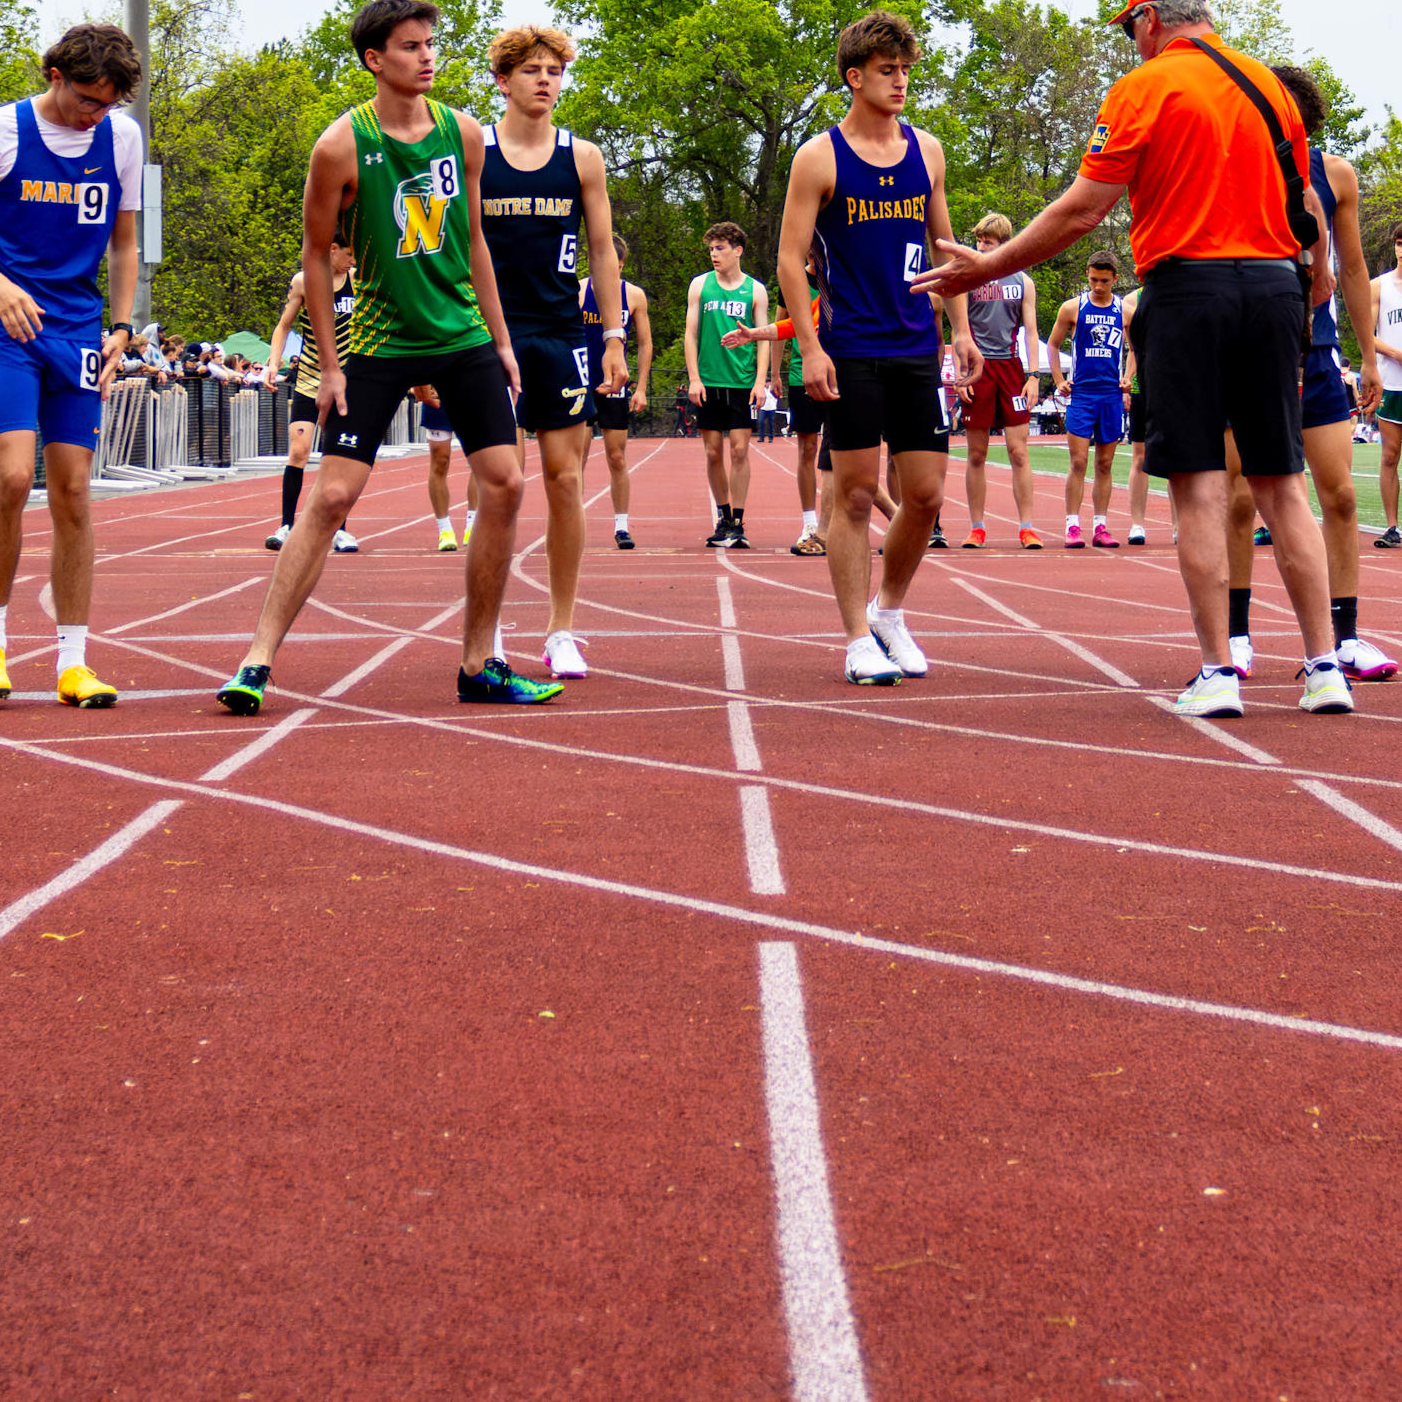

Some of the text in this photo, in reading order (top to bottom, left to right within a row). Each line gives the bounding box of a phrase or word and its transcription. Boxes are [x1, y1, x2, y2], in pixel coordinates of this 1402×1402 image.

[438, 159, 455, 196] 8
[83, 185, 103, 221] 9
[482, 197, 574, 217] NOTRE DAME
[845, 193, 926, 226] PALISADES
[396, 191, 450, 259] N
[562, 236, 577, 270] 5
[907, 247, 920, 276] 4
[1005, 285, 1019, 299] 10
[729, 302, 743, 316] 13
[1085, 347, 1112, 358] MINERS
[1111, 328, 1121, 346] 7
[85, 352, 99, 388] 9
